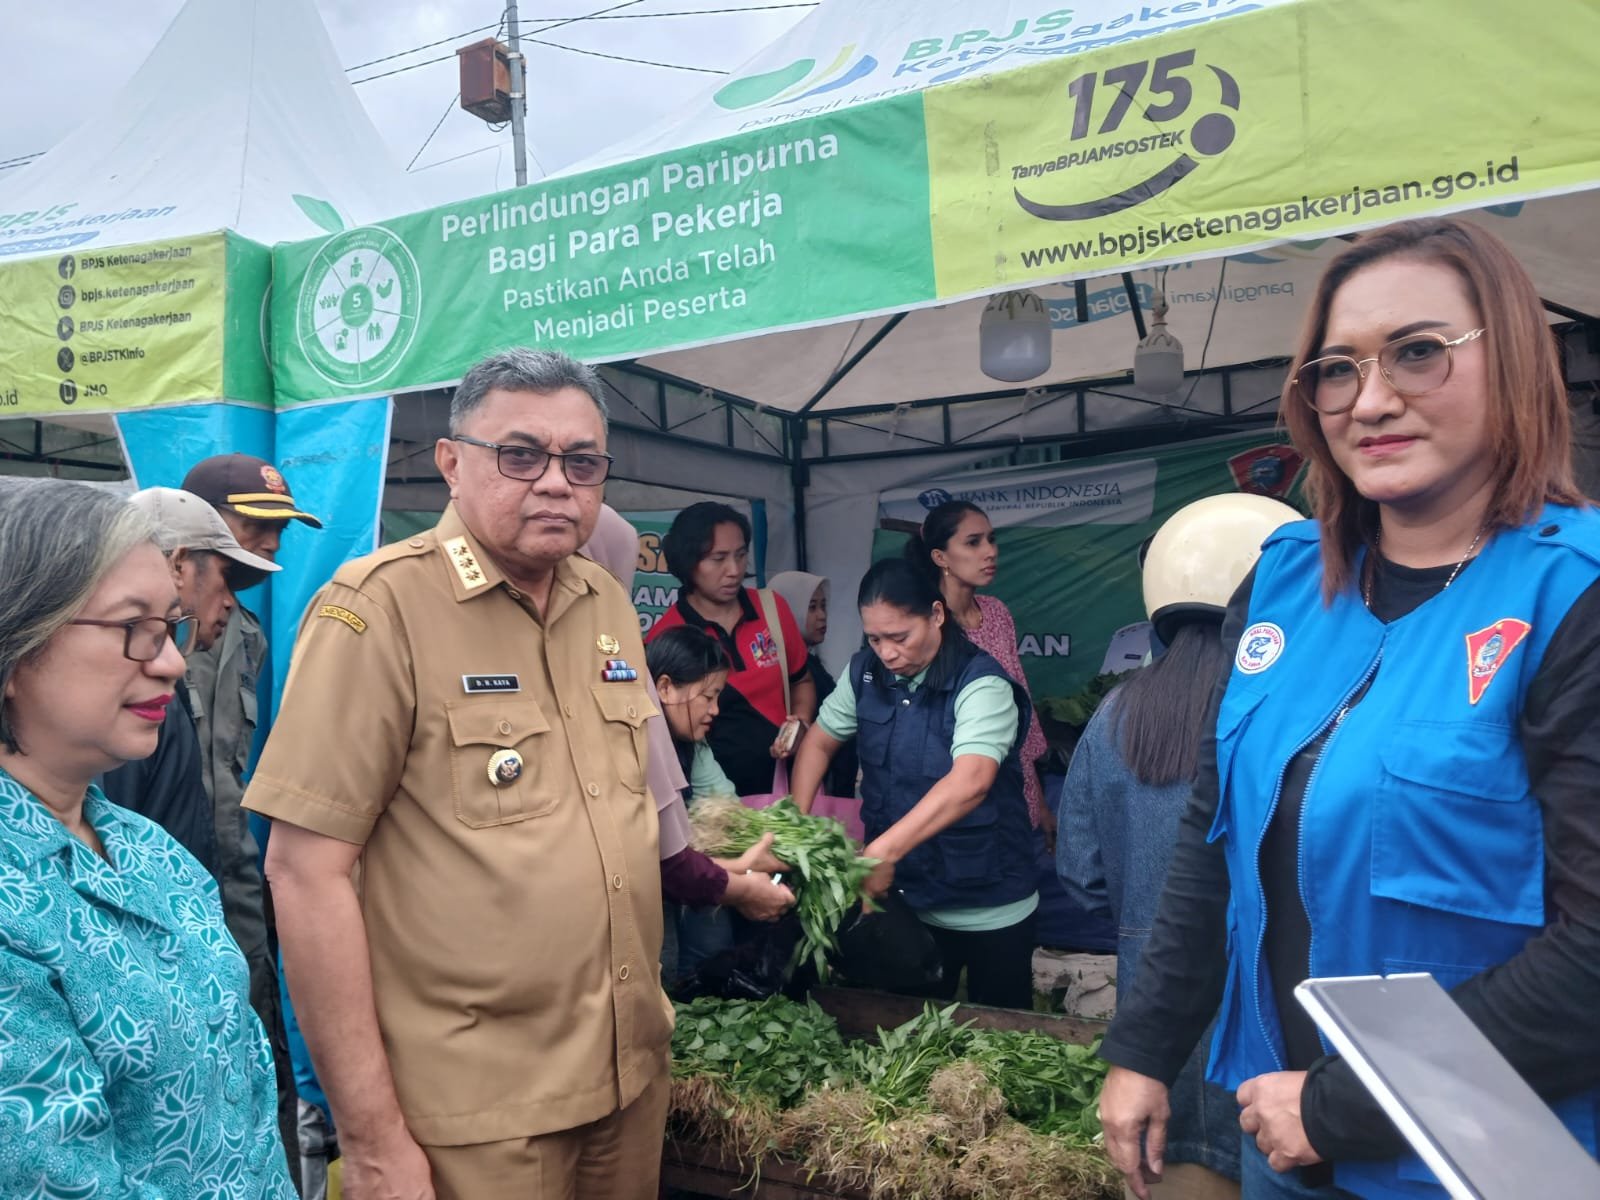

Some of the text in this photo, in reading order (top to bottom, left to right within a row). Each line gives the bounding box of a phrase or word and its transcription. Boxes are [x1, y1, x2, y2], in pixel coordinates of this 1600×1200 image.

[902, 9, 1075, 61] BPJS
[1068, 49, 1196, 141] 175
[1011, 129, 1186, 180] TanyaBPJAMSOSTEK
[441, 133, 839, 242] Perlindungan Paripurna
[1020, 157, 1520, 269] www.bpjsketenagakerjaan.go.id
[81, 245, 192, 270] BPJS Ketenagakerjaan
[488, 191, 783, 274] Bagi Para Pekerja
[81, 278, 195, 303] bpjs.ketenagakerjaan
[503, 238, 776, 312] Pastikan Anda Telah
[79, 311, 192, 333] BPJS Ketenagakerjaan
[533, 286, 747, 343] Menjadi Peserta
[83, 383, 108, 397] JMO
[960, 482, 1122, 503] BANK INDONESIA
